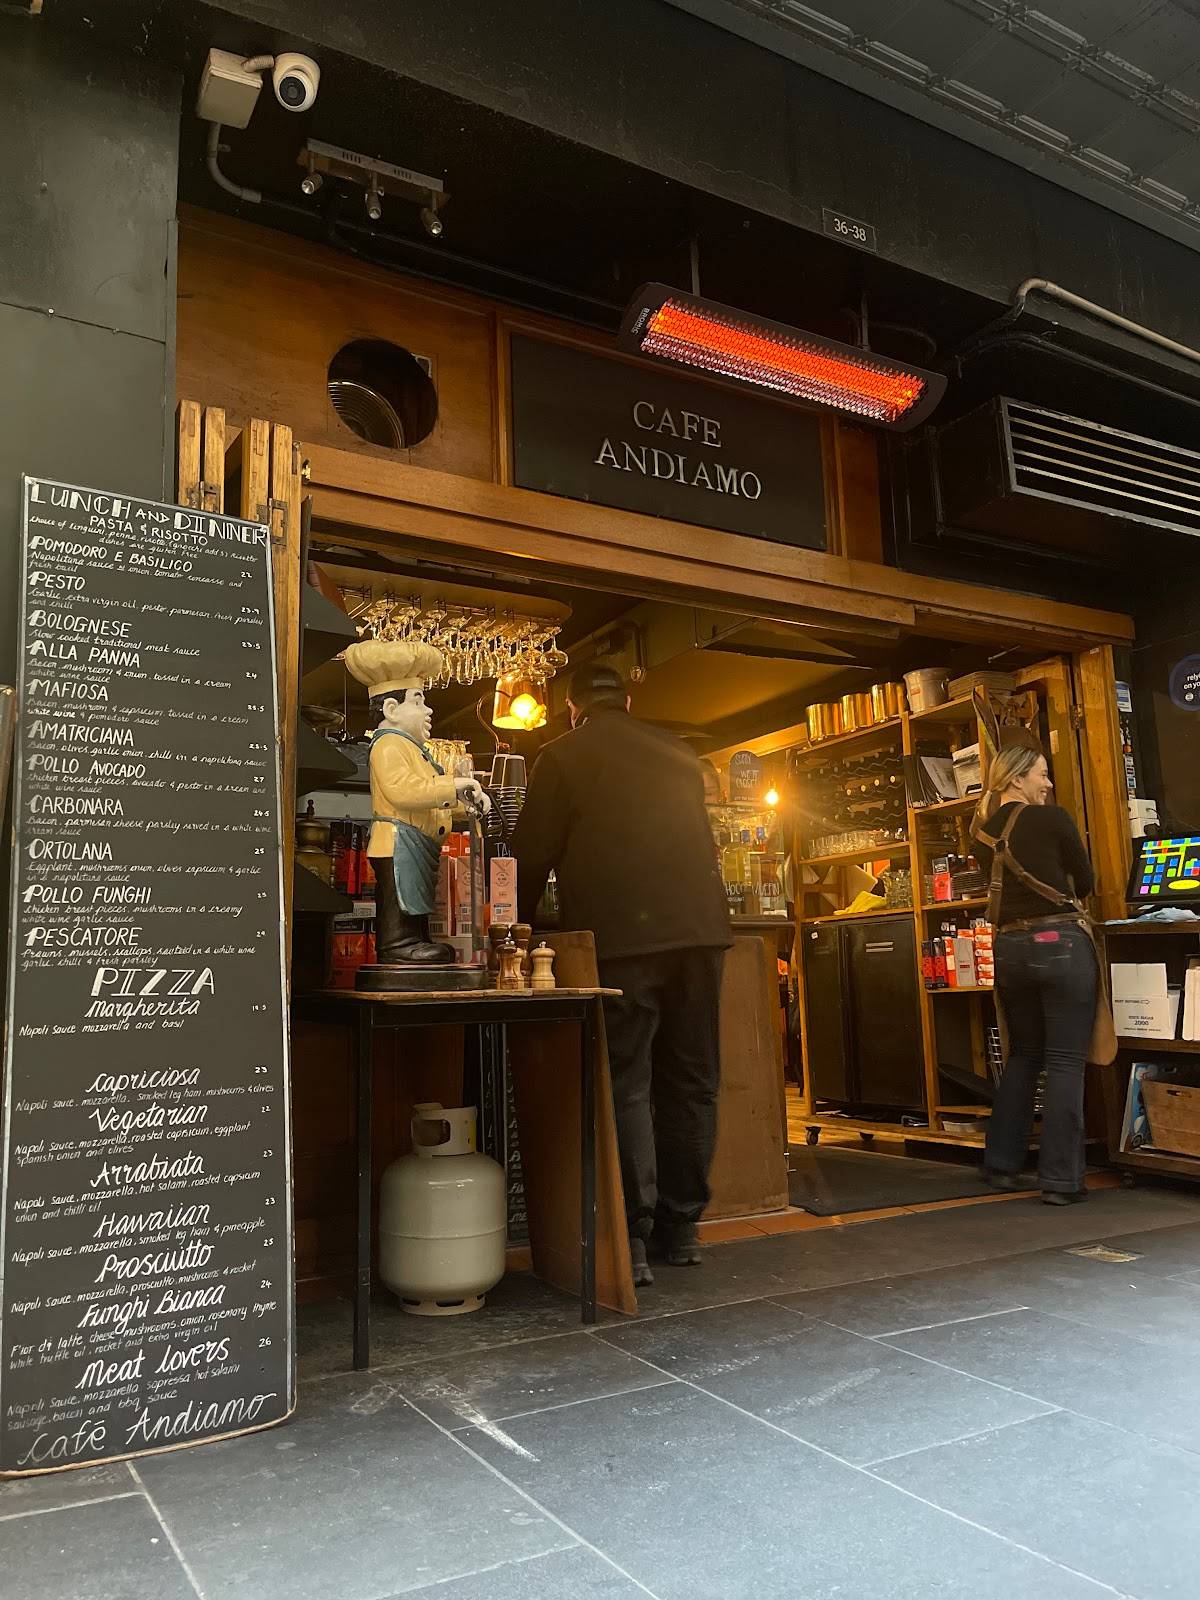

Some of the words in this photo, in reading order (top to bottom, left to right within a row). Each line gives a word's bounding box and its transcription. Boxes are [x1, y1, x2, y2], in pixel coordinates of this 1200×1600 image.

[832, 217, 867, 242] 36-38
[632, 400, 723, 448] CAFE
[594, 437, 762, 501] ANDIAMO
[31, 484, 132, 517] LUNCH
[134, 507, 171, 524] AND
[89, 515, 134, 534] PASTA
[151, 527, 209, 547] RISOTTO
[28, 535, 107, 559] POMODORO
[113, 551, 124, 563] E
[128, 552, 193, 573] BASILICO
[28, 571, 86, 587] PESTO
[26, 609, 133, 639] BOLOGNESE
[25, 639, 78, 661] ALLA
[87, 646, 140, 669] PANNA
[25, 678, 109, 702] MAFIOSA
[25, 719, 134, 747] AMATRICIANA
[25, 753, 80, 774] POLLO
[88, 759, 146, 779] AVOCADO
[24, 794, 124, 817] CARBONARA
[23, 838, 113, 861] ORTOLANA
[21, 883, 84, 904] POLLO
[91, 885, 152, 905] FUNGHI
[23, 925, 143, 949] PESCATORE
[90, 966, 215, 997] PIZZA
[18, 1024, 49, 1039] Napoli
[82, 1021, 130, 1033] mozzarella
[134, 1019, 156, 1030] and
[161, 1018, 185, 1029] basil
[15, 1099, 49, 1114] Napoli
[88, 1099, 209, 1138] Vegetarian
[261, 1105, 271, 1114] 22
[15, 1140, 46, 1155] Napoli
[213, 1120, 252, 1137] eggplant
[56, 1150, 81, 1161] onion
[85, 1145, 105, 1158] and
[89, 1149, 205, 1188] Arrabiata
[262, 1149, 274, 1158] 23
[13, 1195, 45, 1214] Napoli
[138, 1182, 156, 1194] hot
[190, 1173, 221, 1188] roasted
[41, 1207, 61, 1220] and
[92, 1202, 211, 1239] Hawaiian
[264, 1196, 276, 1206] 23
[11, 1246, 45, 1263] Napoli
[138, 1229, 172, 1245] smoked
[189, 1226, 211, 1238] ham
[220, 1216, 266, 1238] pineapple
[263, 1237, 274, 1247] 25
[10, 1295, 42, 1316] Napoli
[229, 1258, 257, 1275] rocket
[77, 1293, 152, 1339] Funghi
[153, 1284, 227, 1315] Bianca
[260, 1279, 273, 1289] 24
[57, 1332, 84, 1350] latte
[206, 1306, 248, 1328] rosemary
[74, 1348, 146, 1390] Meat
[258, 1336, 272, 1348] 26
[83, 1382, 139, 1403] mozzarella
[87, 1400, 112, 1416] and
[117, 1396, 142, 1413] bbq
[124, 1392, 278, 1445] Andiamo
